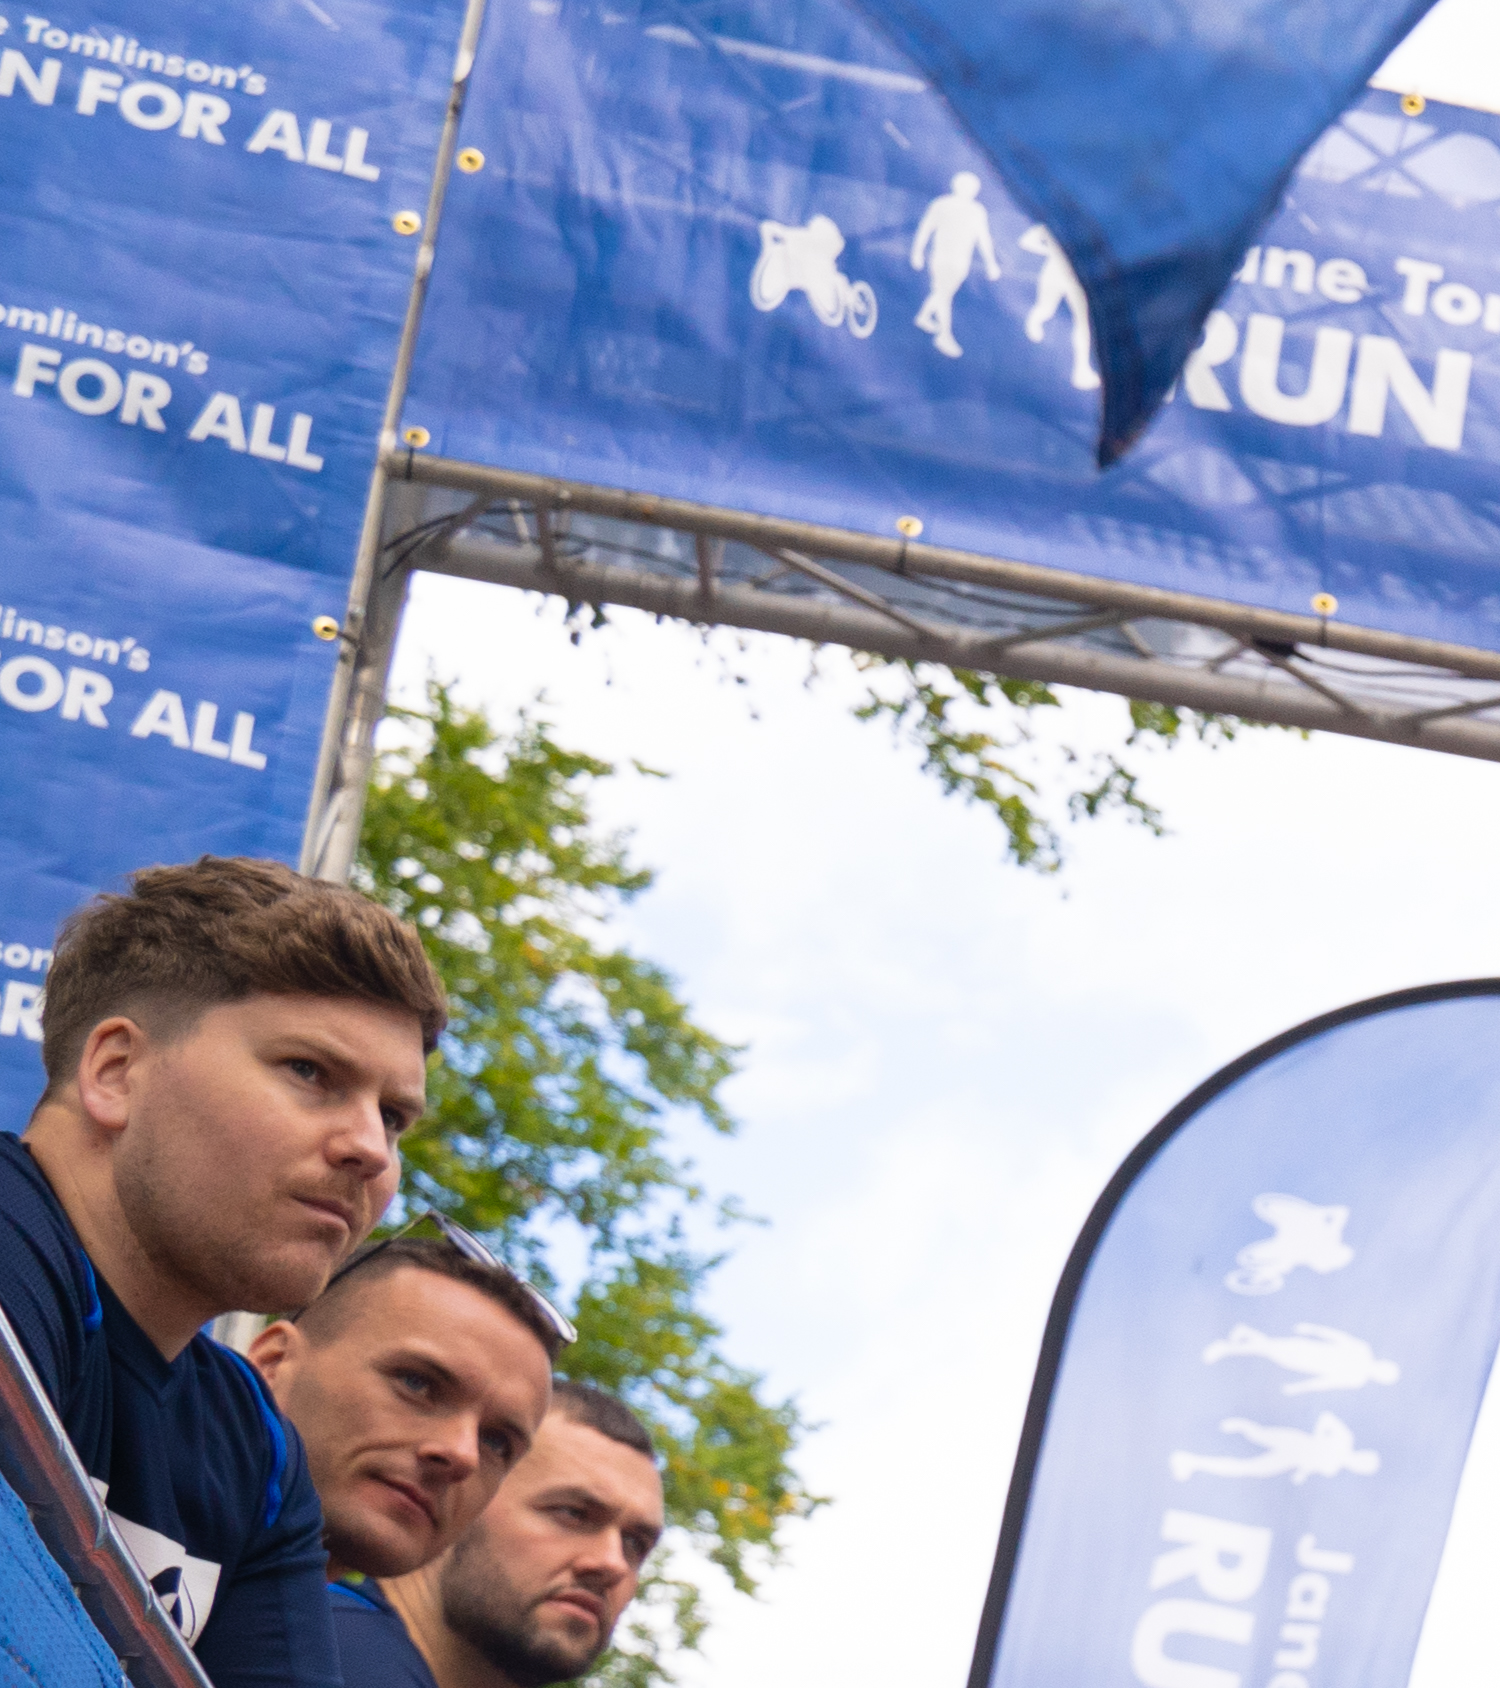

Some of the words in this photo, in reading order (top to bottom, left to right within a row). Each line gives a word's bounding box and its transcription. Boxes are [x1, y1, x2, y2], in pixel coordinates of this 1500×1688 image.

[24, 14, 267, 96] Tomlinson's
[76, 66, 231, 145] FOR
[245, 109, 380, 182] ALL
[1232, 246, 1368, 303] ne
[13, 342, 172, 432] FOR
[188, 391, 324, 472] ALL
[1167, 309, 1473, 451] RUN
[0, 603, 151, 673] inson's
[0, 654, 114, 728] OR
[131, 689, 268, 771] ALL
